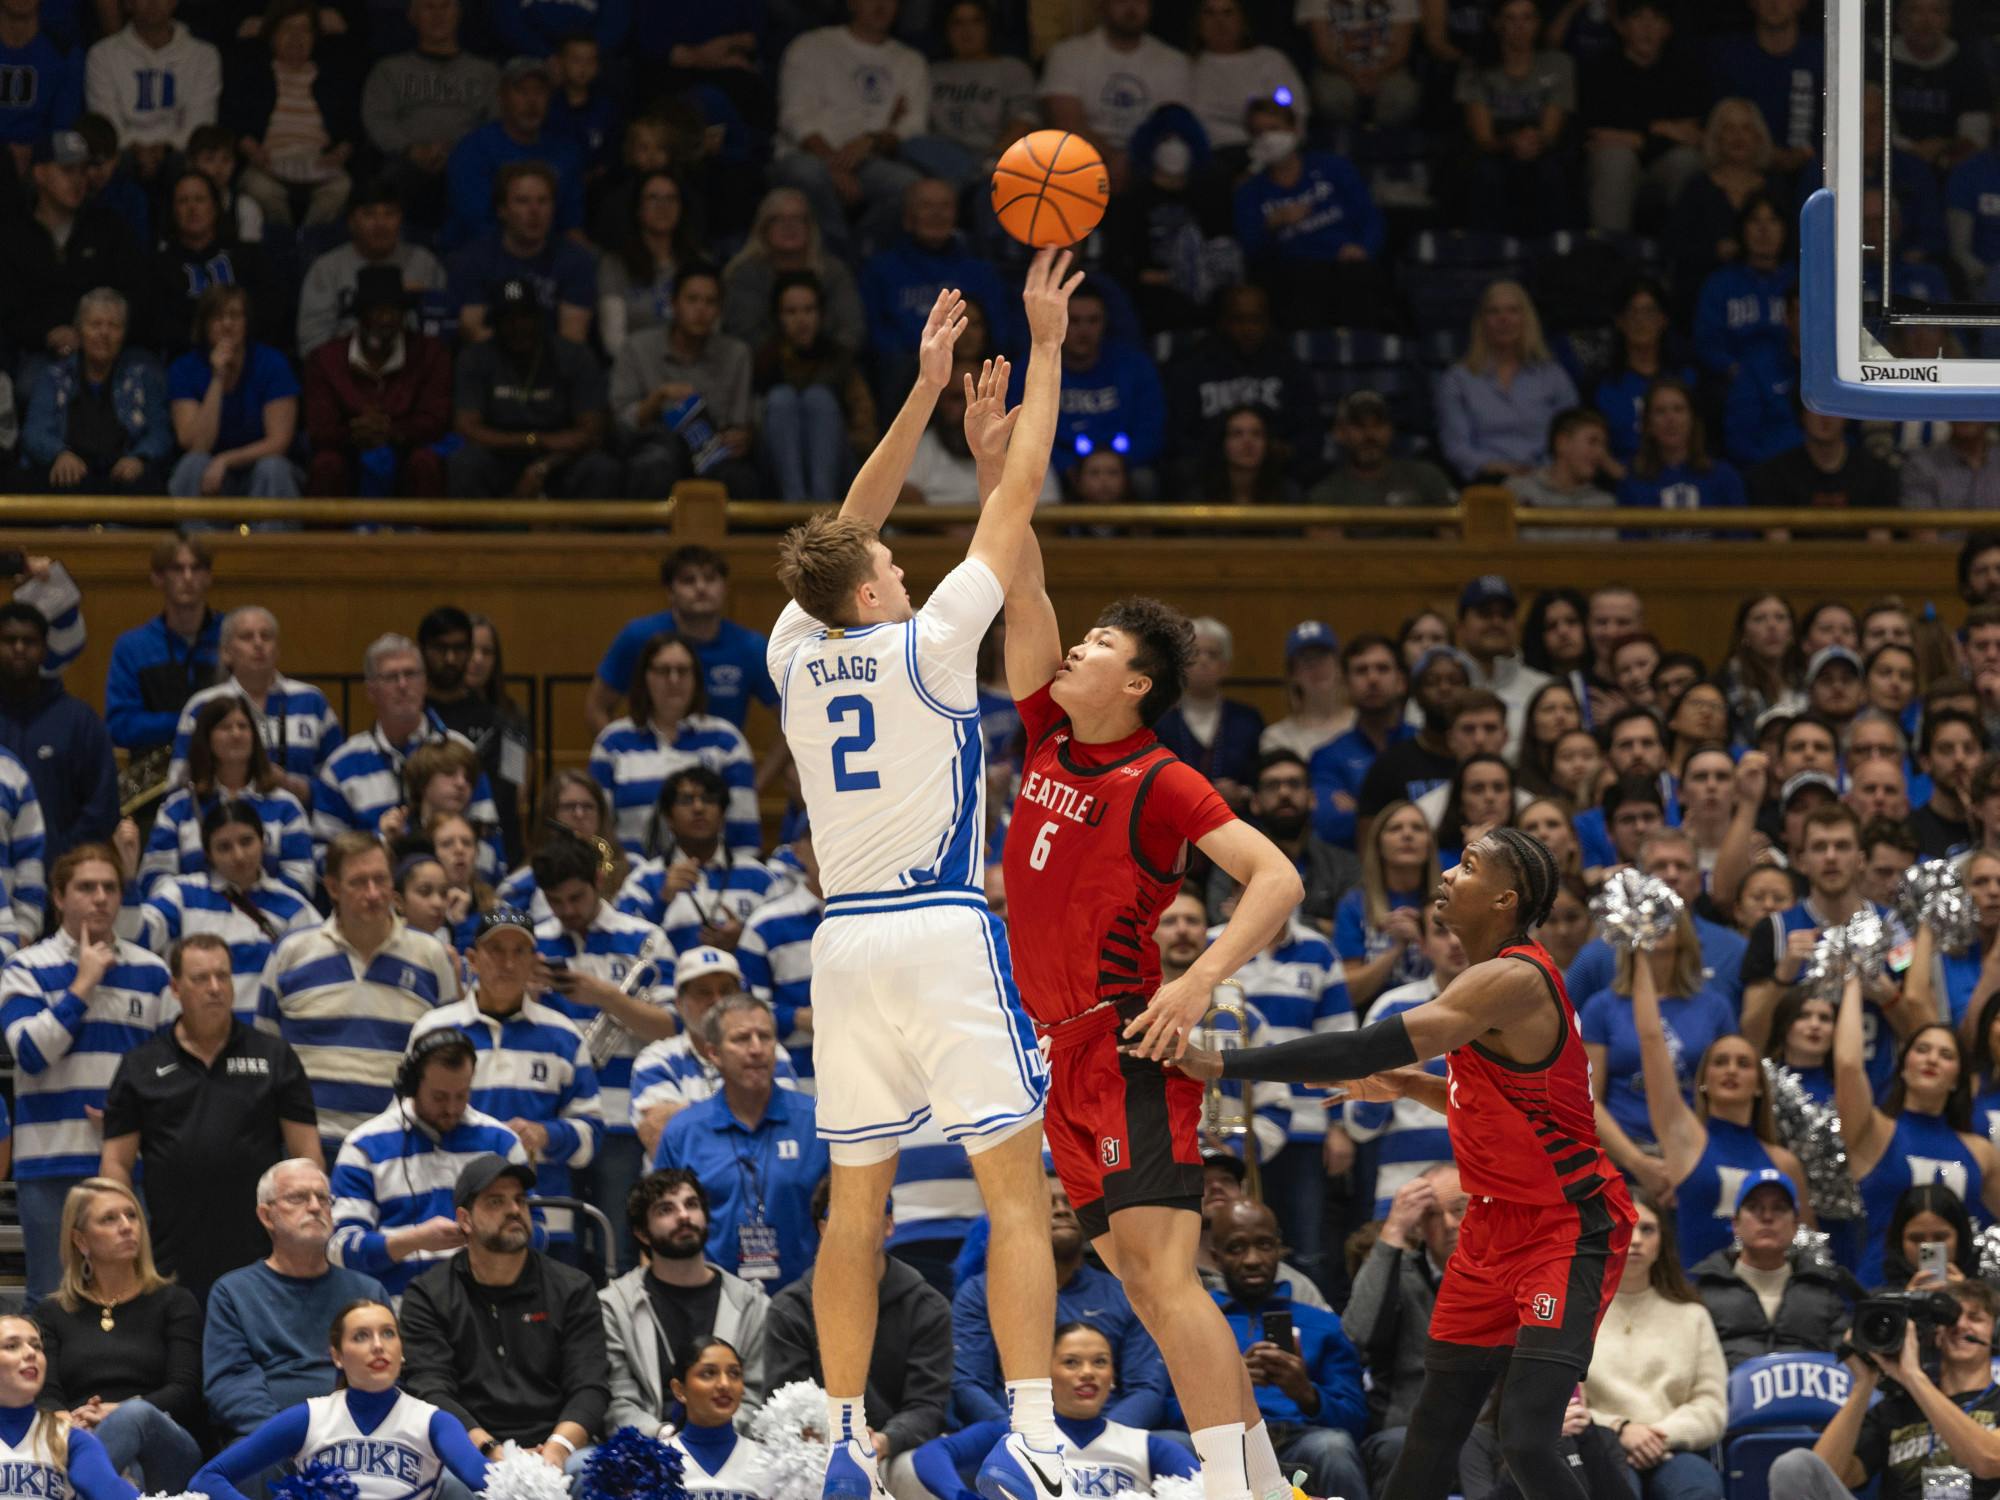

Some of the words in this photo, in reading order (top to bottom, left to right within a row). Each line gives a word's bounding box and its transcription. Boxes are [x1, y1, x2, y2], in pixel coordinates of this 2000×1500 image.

[1859, 364, 1938, 383] SPALDING
[806, 656, 878, 687] FLAGG
[826, 694, 881, 792] 2
[1029, 821, 1059, 871] 6
[226, 1056, 270, 1075] DUKE
[531, 1060, 549, 1082] D
[776, 1139, 799, 1161] D
[1751, 1362, 1849, 1410] DUKE
